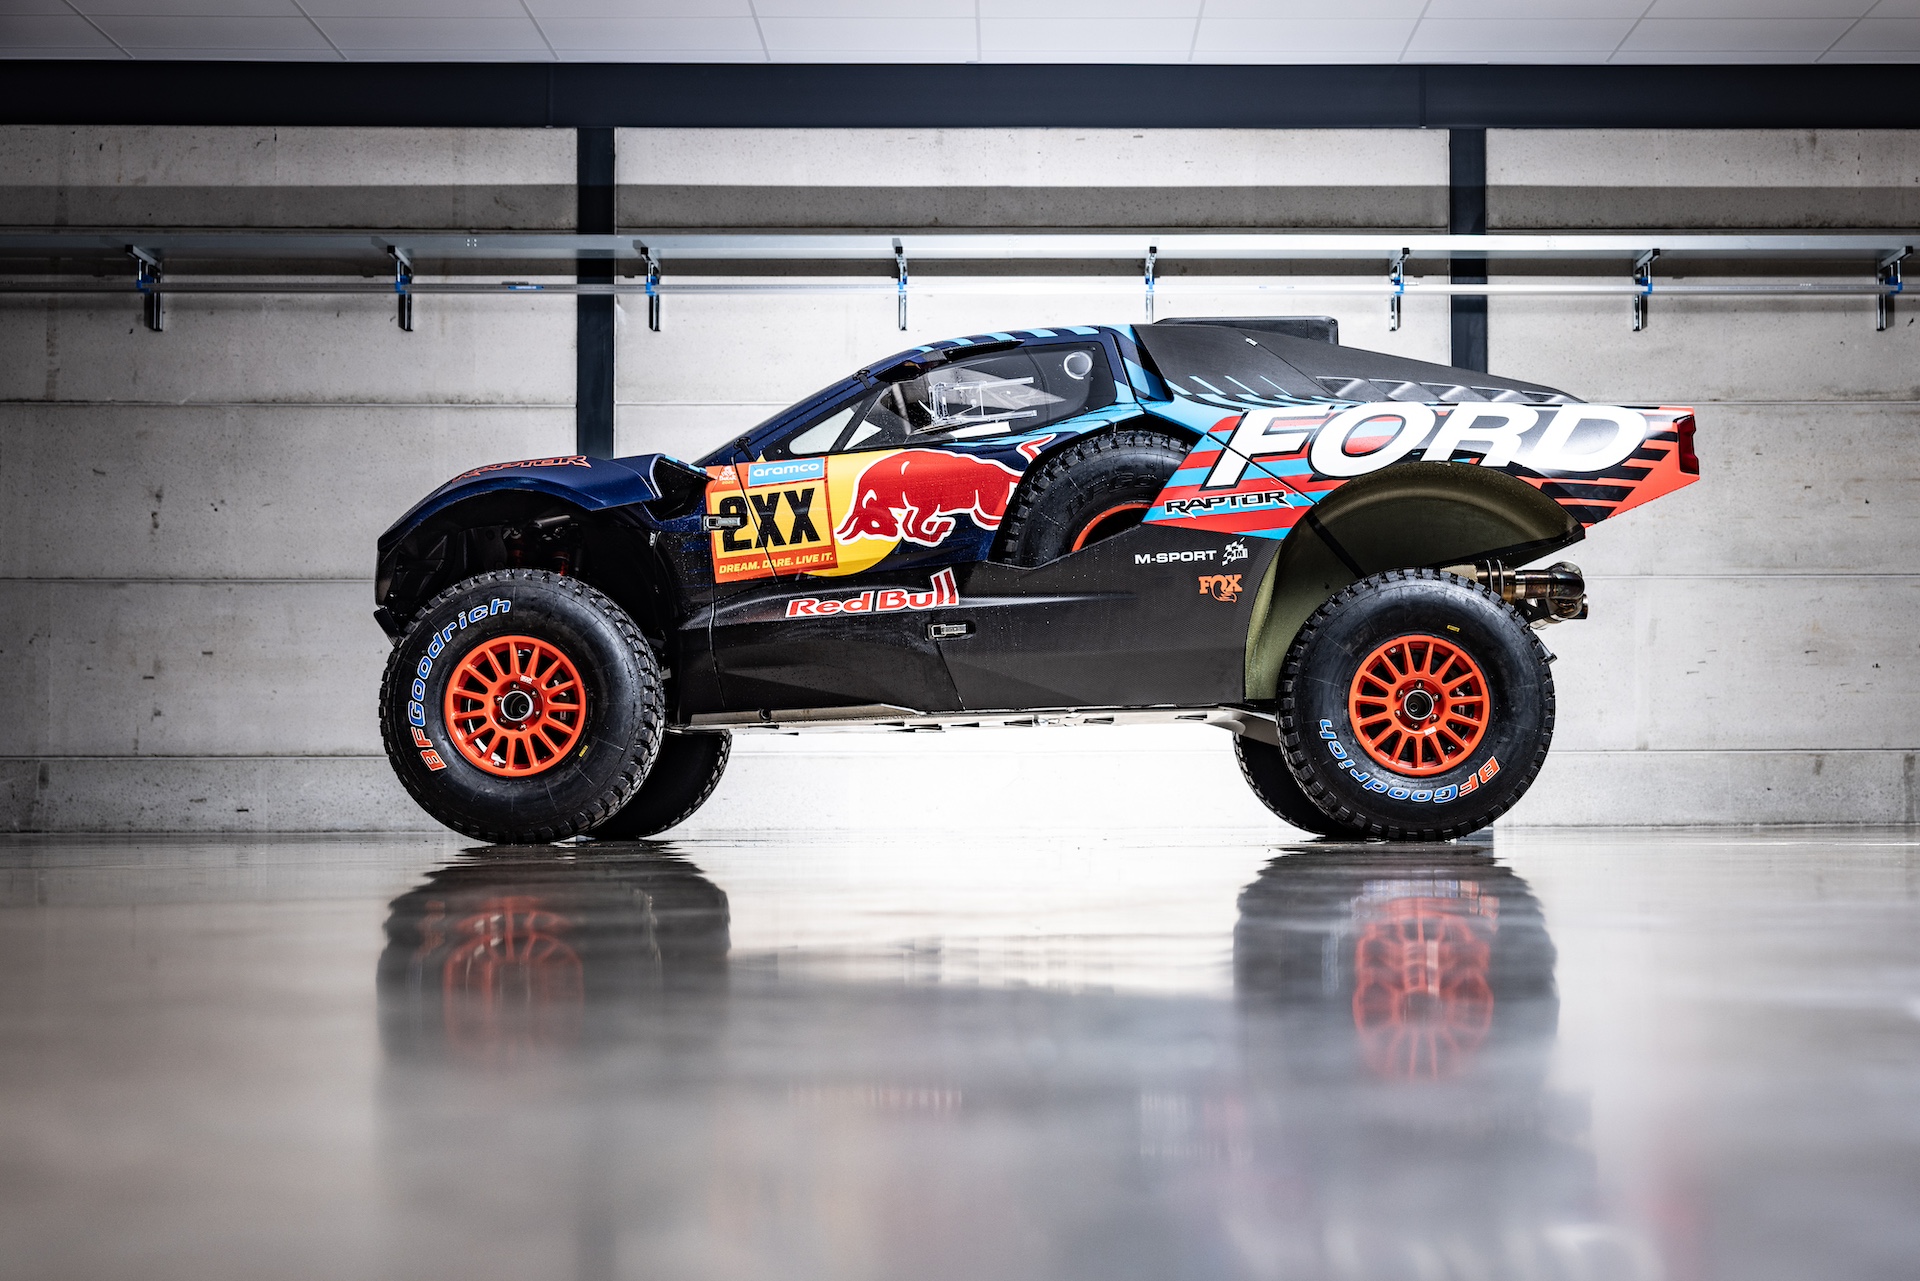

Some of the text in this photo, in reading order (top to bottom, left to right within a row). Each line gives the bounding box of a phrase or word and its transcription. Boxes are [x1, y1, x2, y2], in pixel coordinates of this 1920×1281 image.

[1202, 401, 1648, 489] FORD
[753, 463, 820, 477] aramco
[719, 488, 821, 552] 2XX
[1164, 490, 1295, 519] RAPTOR
[719, 552, 834, 574] DREAM. DARE. LIVE IT.
[1134, 550, 1217, 565] M-SPORT
[786, 567, 959, 617] Red Bull
[1198, 574, 1243, 603] FOX
[408, 597, 512, 772] BFGoodrich
[1318, 718, 1500, 804] BFGoodrich
